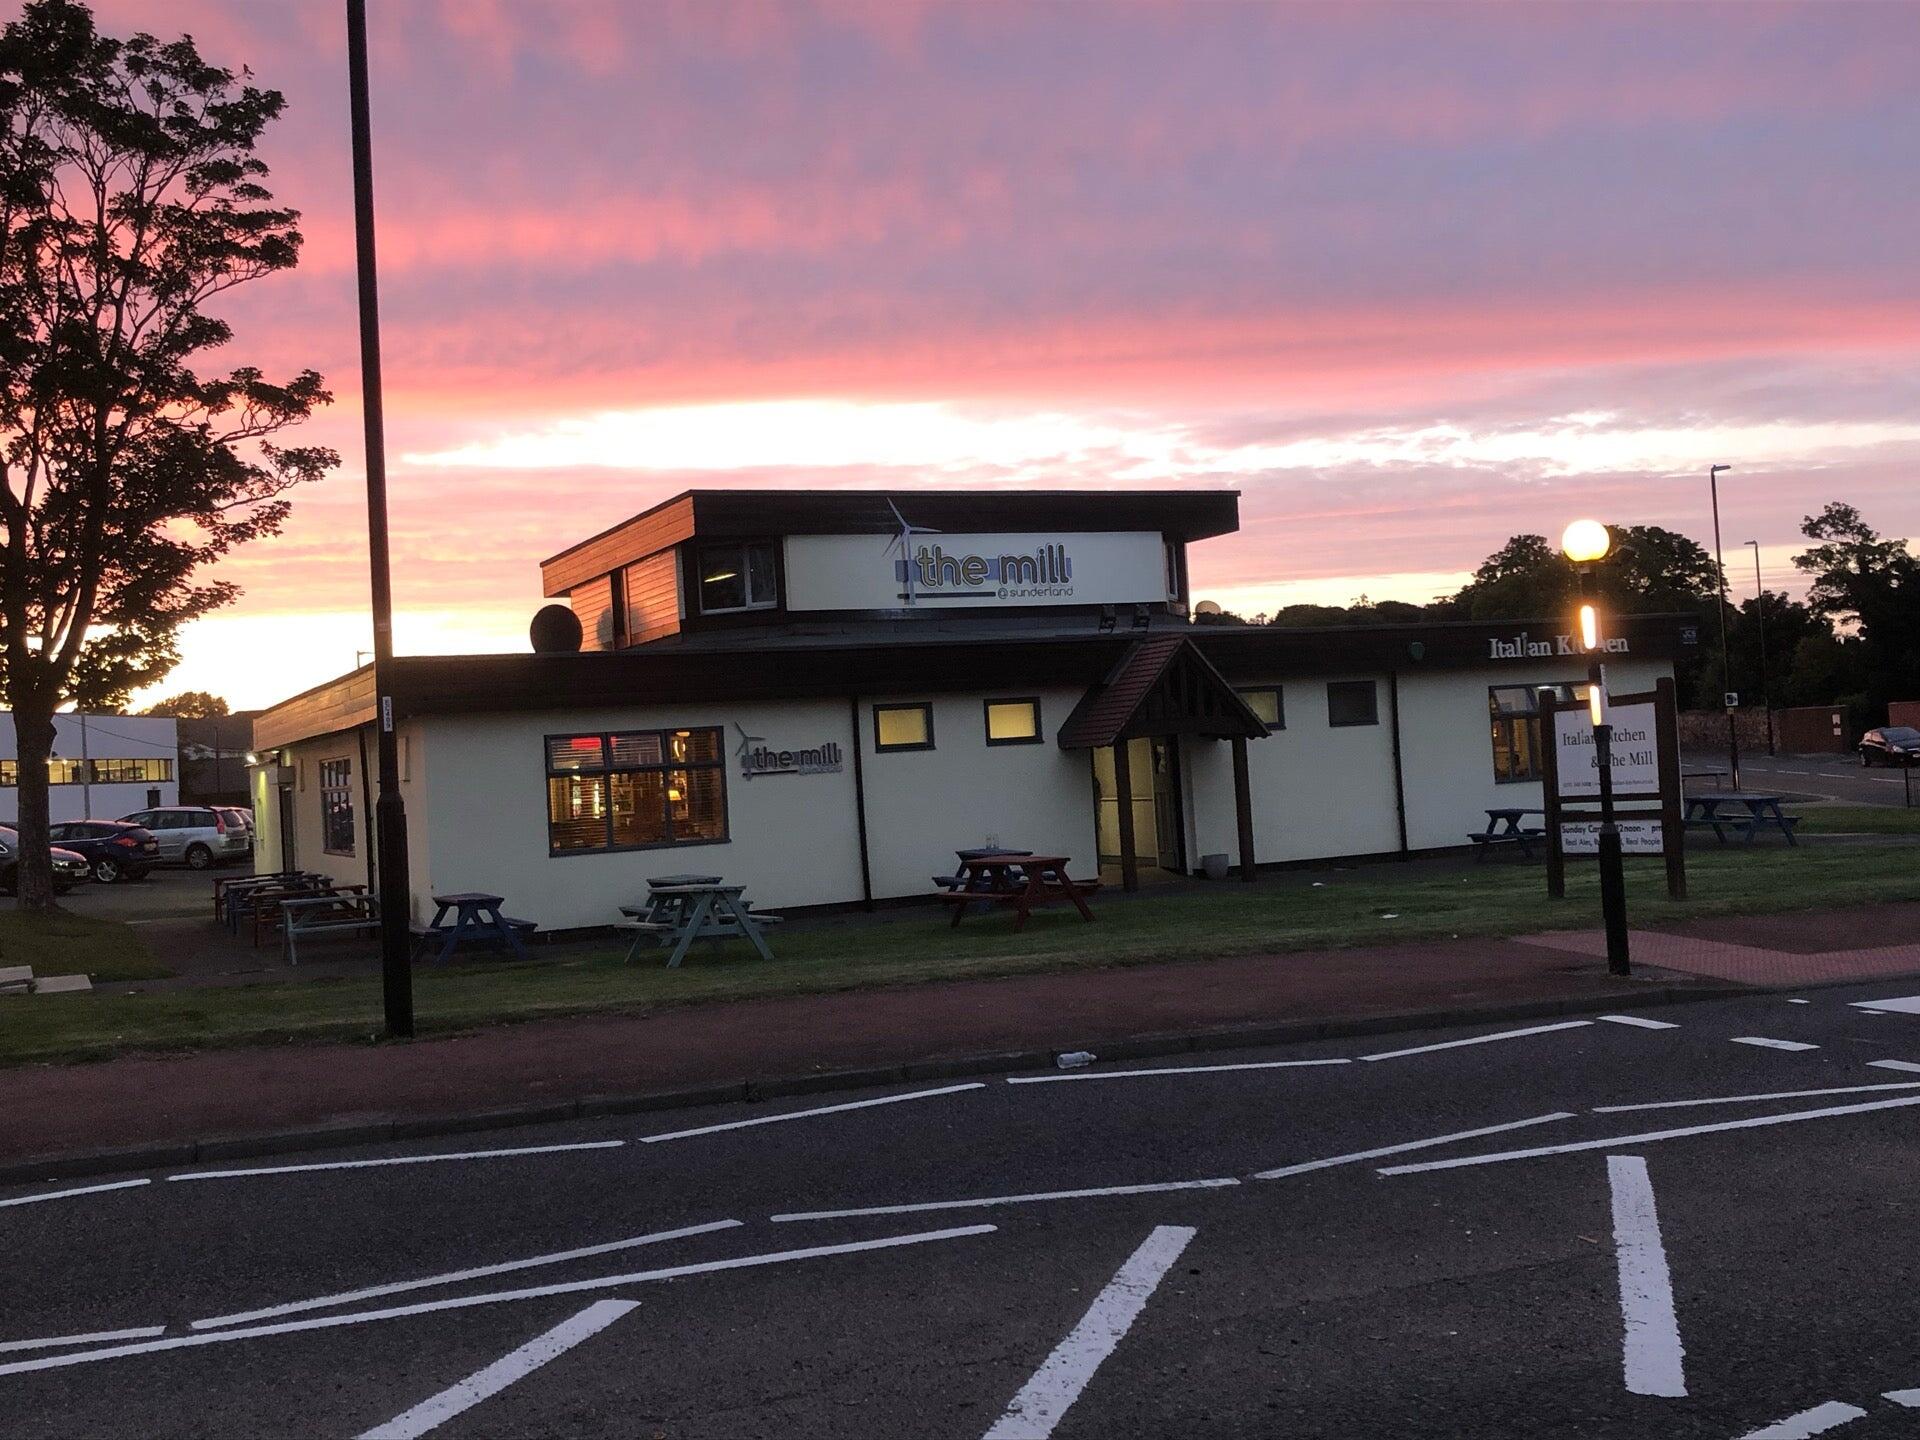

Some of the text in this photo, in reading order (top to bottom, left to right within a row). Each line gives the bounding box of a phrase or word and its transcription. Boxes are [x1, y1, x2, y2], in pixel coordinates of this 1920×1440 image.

[916, 544, 1070, 587] the mill
[1488, 632, 1552, 659] Italian
[753, 742, 841, 769] the mill
[1610, 753, 1626, 768] he
[1629, 751, 1654, 766] Mill
